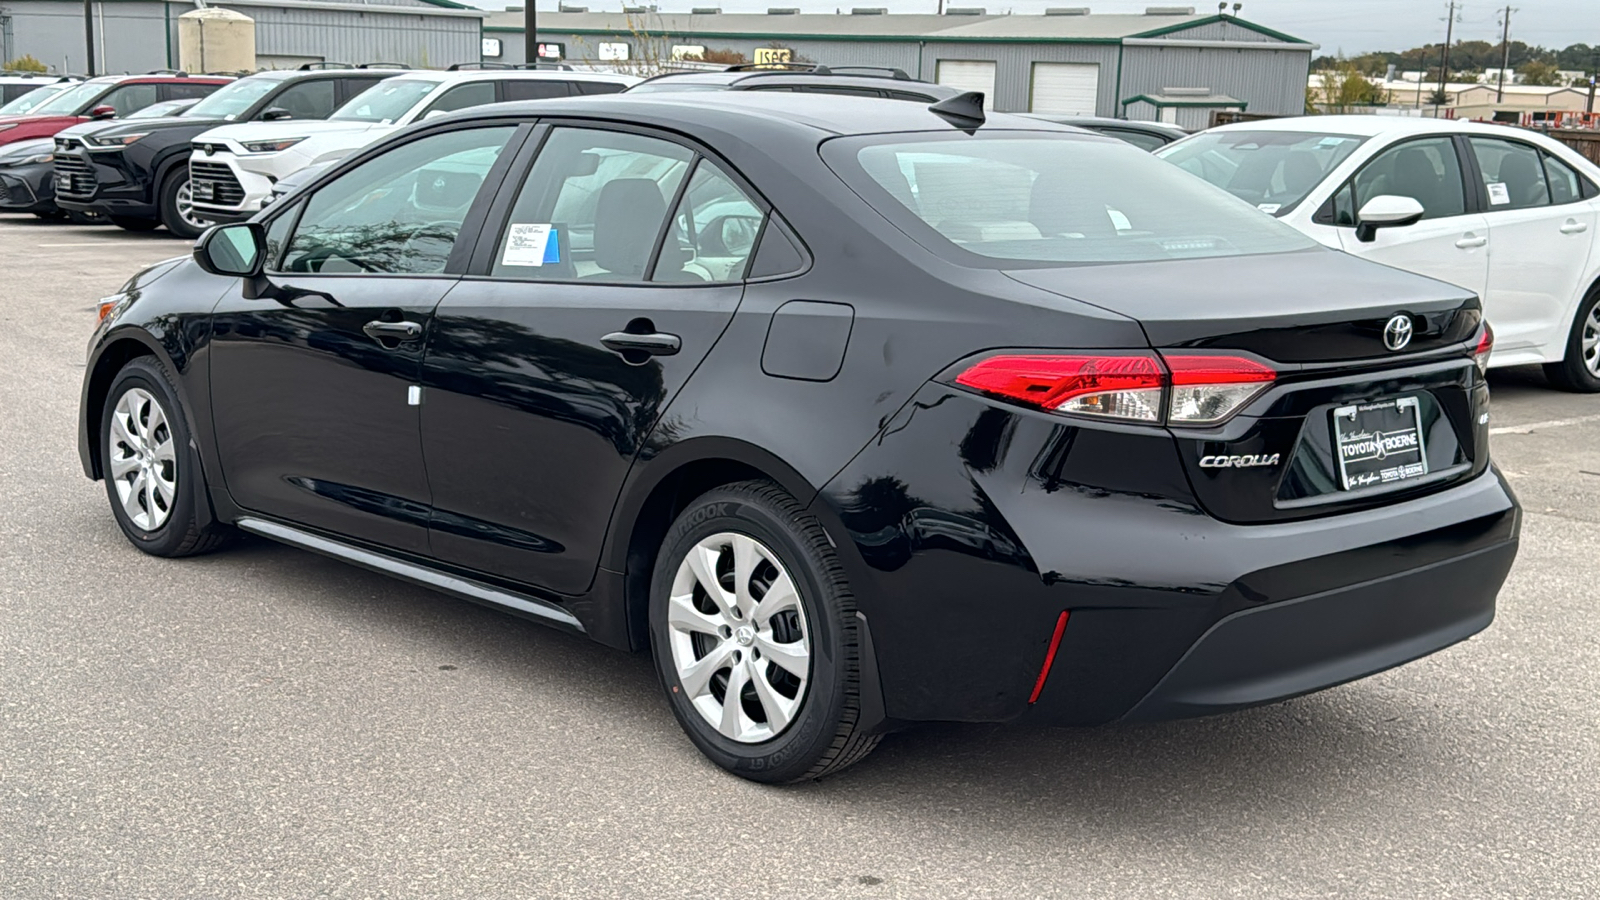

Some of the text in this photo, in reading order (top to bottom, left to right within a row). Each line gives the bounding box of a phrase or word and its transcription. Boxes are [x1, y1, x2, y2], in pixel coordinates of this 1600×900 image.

[1342, 433, 1418, 457] TOYOTA BOERNE
[1199, 453, 1280, 468] COROLLA
[1381, 470, 1398, 480] TOYOTA
